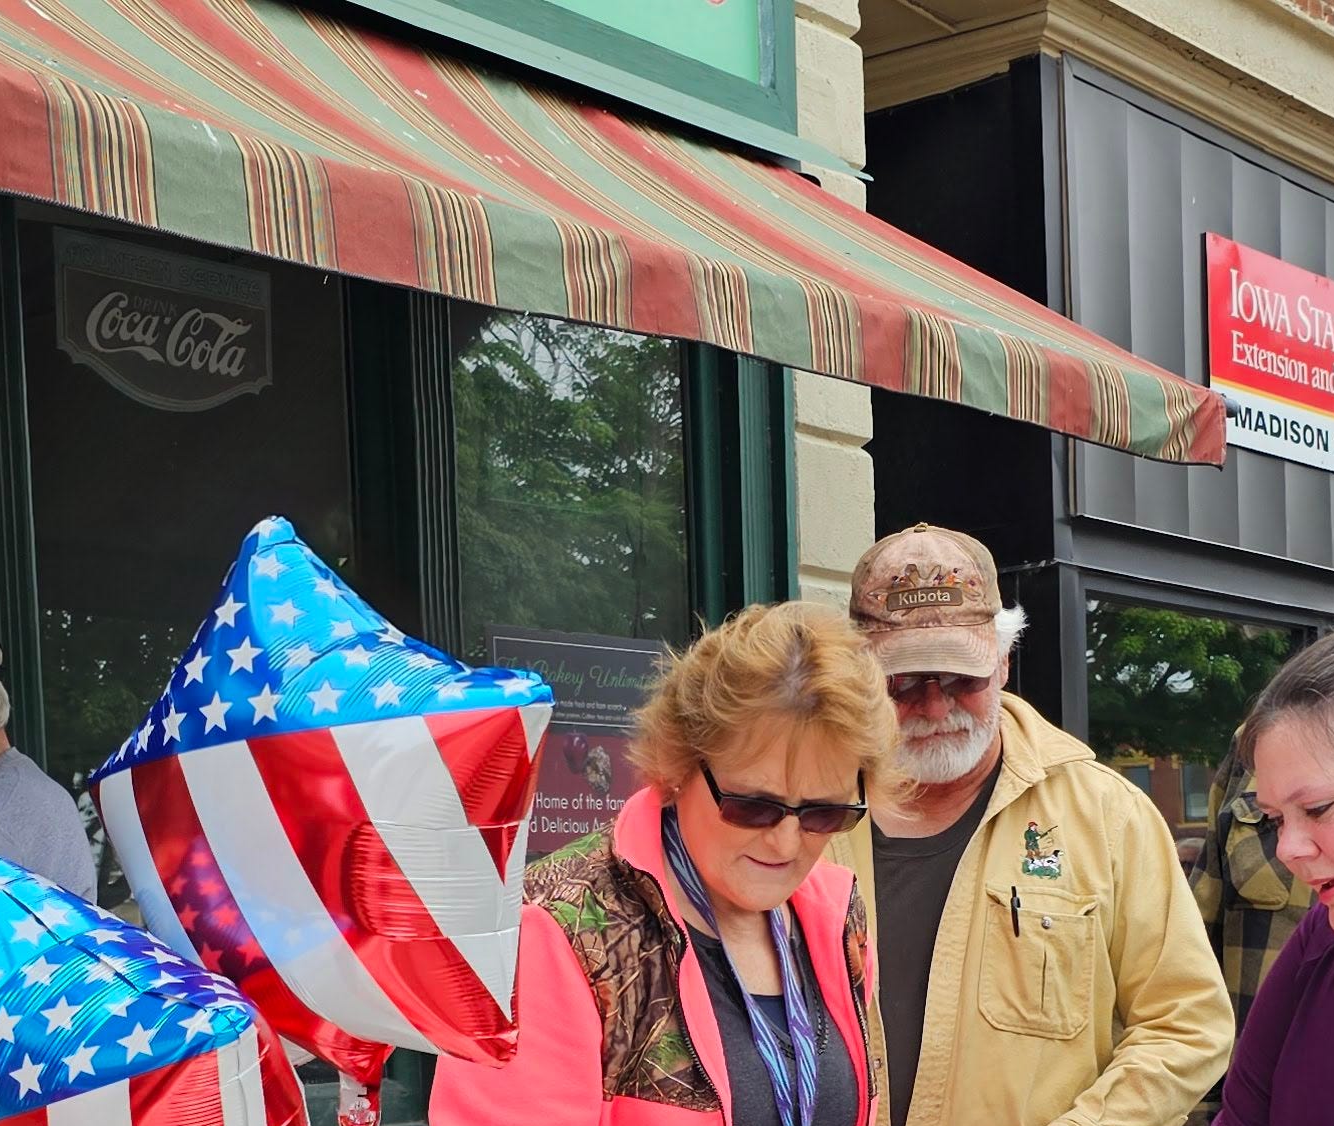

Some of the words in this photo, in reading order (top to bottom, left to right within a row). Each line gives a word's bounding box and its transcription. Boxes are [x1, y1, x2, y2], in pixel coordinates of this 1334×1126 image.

[133, 295, 179, 317] DRINK
[1230, 268, 1293, 338] IOWA
[1230, 330, 1310, 386] Extension
[1234, 405, 1330, 453] MADISON
[898, 590, 951, 606] Kubota
[535, 792, 569, 809] Home
[571, 793, 583, 810] of
[586, 794, 603, 810] the
[606, 794, 626, 811] fam
[541, 816, 589, 834] Delicious
